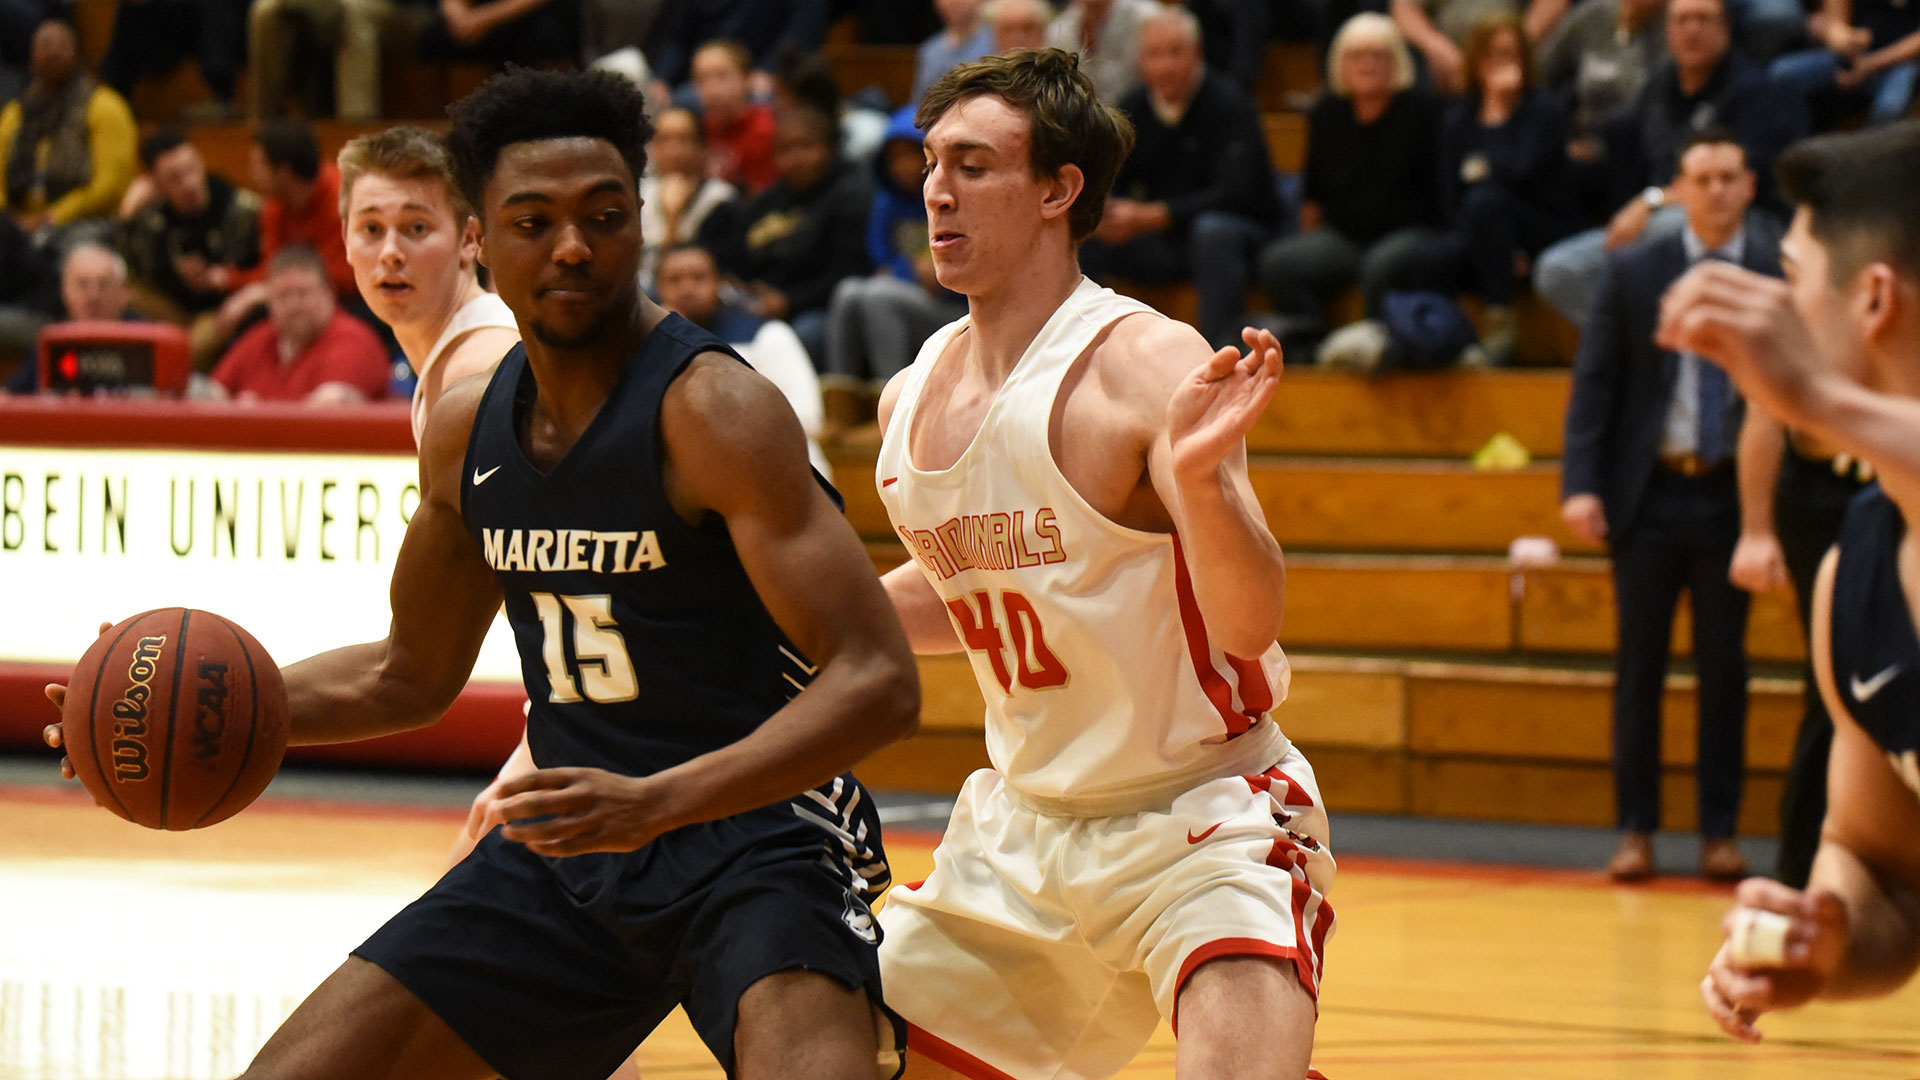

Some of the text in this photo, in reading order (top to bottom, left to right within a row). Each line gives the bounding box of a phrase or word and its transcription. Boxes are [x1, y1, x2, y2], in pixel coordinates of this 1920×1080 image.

[2, 473, 127, 554] BEIN
[482, 528, 668, 573] MARIETTA
[898, 507, 1067, 581] RDINALS
[529, 591, 640, 704] 15
[946, 587, 1072, 698] 40
[111, 634, 167, 784] Wilson
